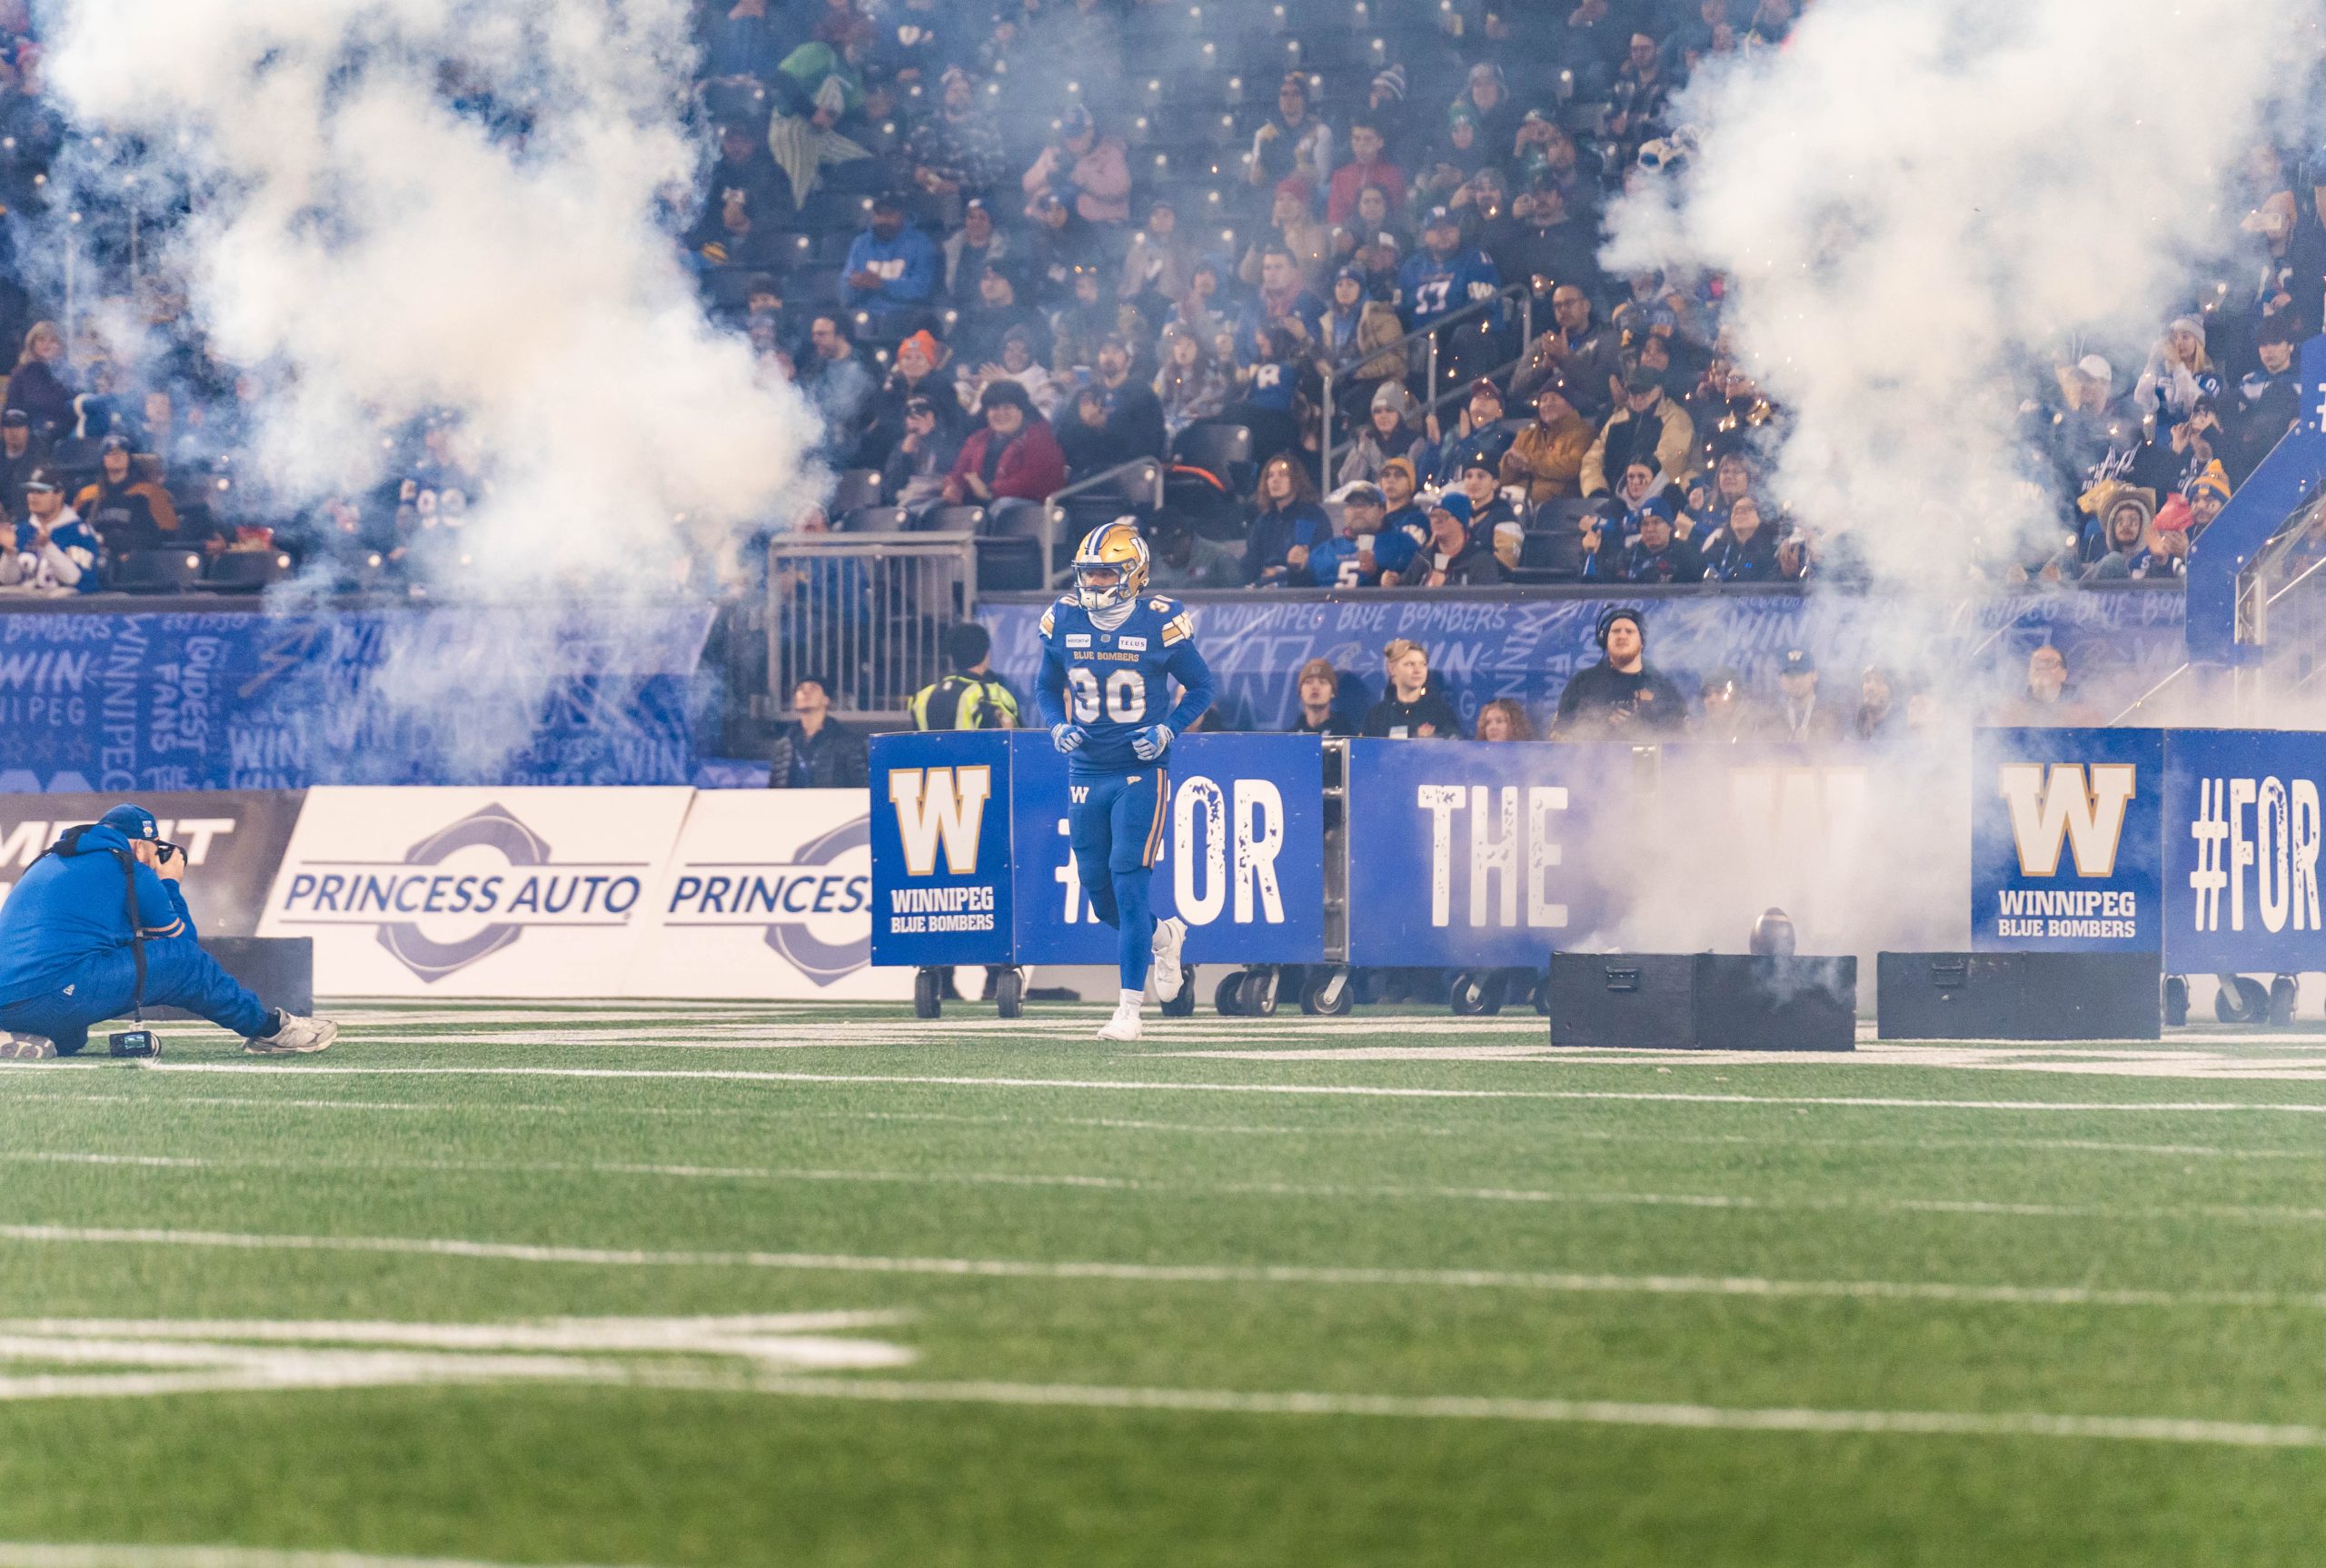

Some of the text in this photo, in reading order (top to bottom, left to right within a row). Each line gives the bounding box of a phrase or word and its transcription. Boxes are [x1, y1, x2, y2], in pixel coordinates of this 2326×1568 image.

[1335, 561, 1360, 589] 5
[1215, 602, 1506, 632] WINNIPEG BLUE BOMBERS
[1073, 650, 1139, 662] BLUE BOMBERS
[1120, 640, 1146, 648] TELUS
[0, 649, 90, 694] WIN
[101, 614, 158, 793] WINNIPEG
[149, 662, 181, 753] FANS
[181, 636, 220, 756] LOUDEST
[1069, 668, 1147, 724] 30
[229, 726, 309, 770] WIN
[1069, 786, 1089, 804] W
[889, 765, 991, 876] W
[1999, 763, 2136, 877] W
[1417, 785, 1568, 928] THE
[2190, 776, 2321, 933] #FOR
[284, 874, 641, 913] PRINCESS AUTO
[668, 875, 872, 914] PRINCES
[890, 886, 994, 914] WINNIPEG
[1999, 890, 2136, 917] WINNIPEG
[890, 913, 994, 933] BLUE BOMBERS
[1999, 918, 2136, 938] BLUE BOMBERS
